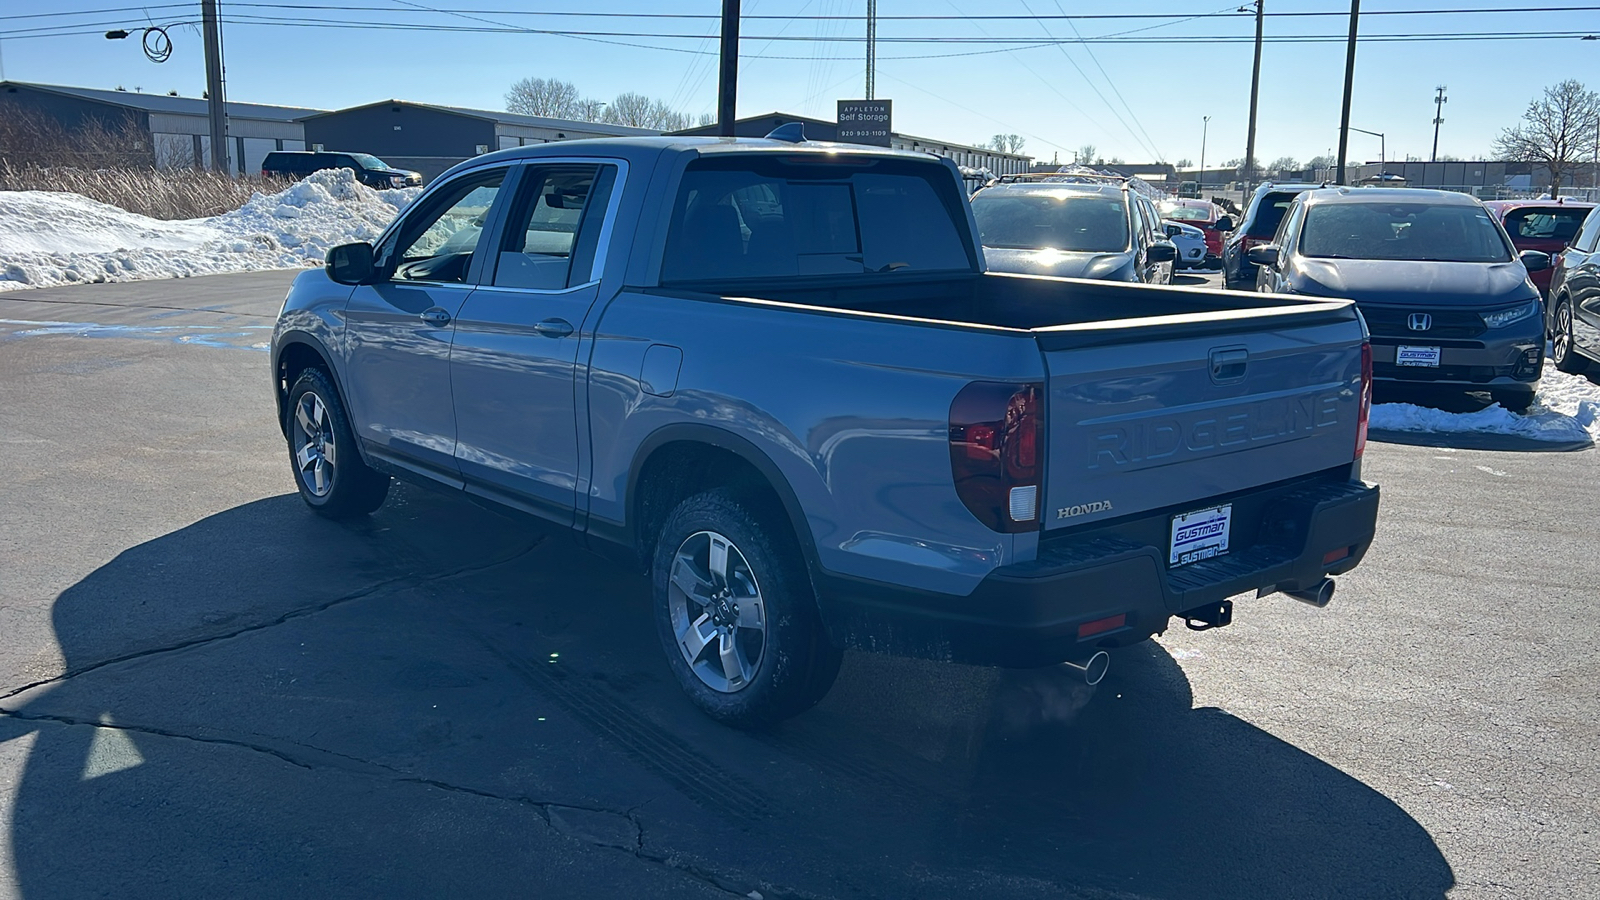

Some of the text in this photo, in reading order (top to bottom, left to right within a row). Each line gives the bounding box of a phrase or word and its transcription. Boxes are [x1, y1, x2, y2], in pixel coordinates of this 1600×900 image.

[840, 113, 889, 122] Self Storage
[1087, 397, 1340, 469] RIDGELINE
[1057, 500, 1114, 520] HONDA
